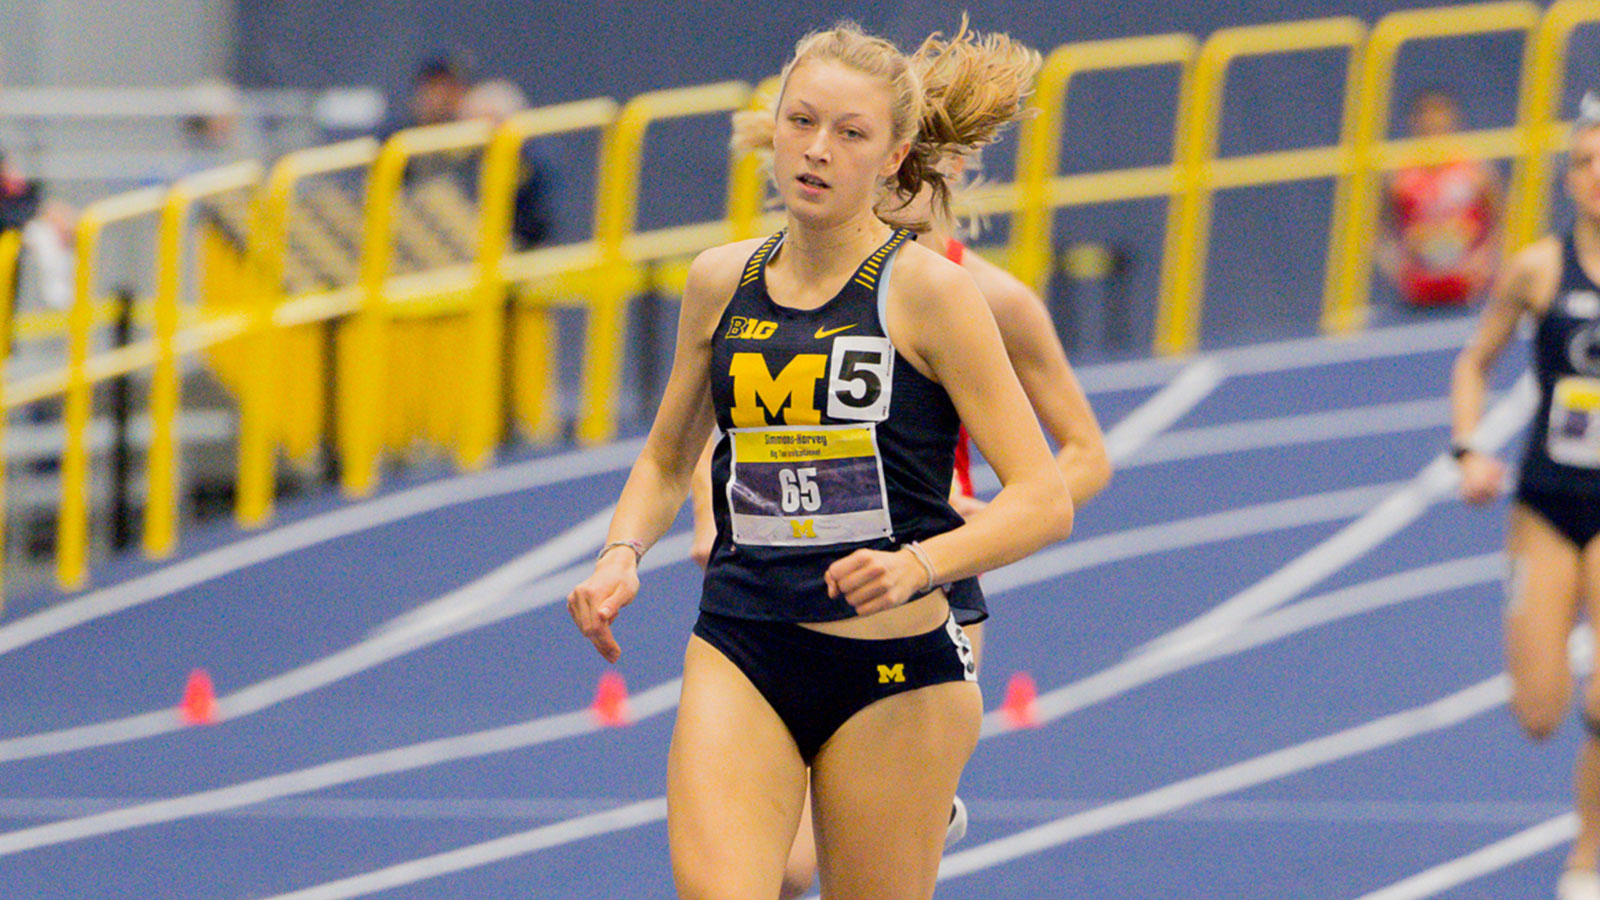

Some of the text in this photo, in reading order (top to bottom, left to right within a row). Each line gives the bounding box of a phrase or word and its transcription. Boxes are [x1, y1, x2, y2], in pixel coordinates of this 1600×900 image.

[729, 352, 828, 428] M
[835, 350, 882, 409] 5
[778, 467, 822, 513] 65
[789, 519, 817, 539] M
[876, 663, 906, 684] M
